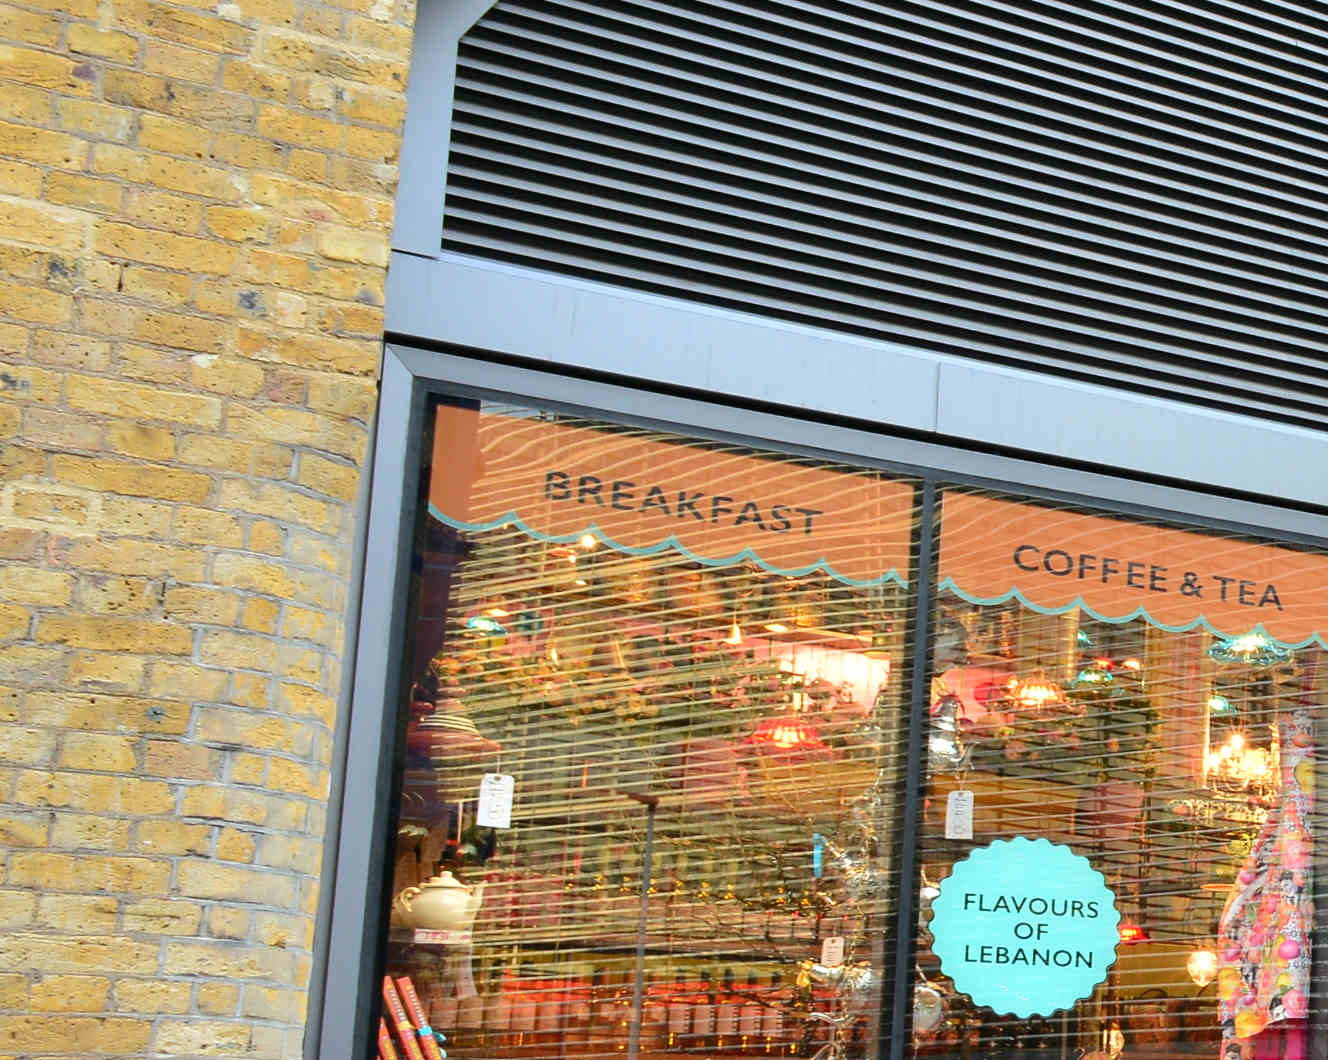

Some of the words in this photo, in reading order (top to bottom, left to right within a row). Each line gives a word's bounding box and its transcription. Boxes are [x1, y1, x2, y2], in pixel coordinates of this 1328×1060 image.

[544, 470, 823, 535] BREAKFAST
[1013, 544, 1169, 593] COFFEE
[1179, 571, 1203, 598] &
[1212, 575, 1284, 612] TEA
[963, 893, 1099, 919] FLAVOURS
[1014, 922, 1049, 941] OF
[964, 944, 1094, 969] LEBANON
